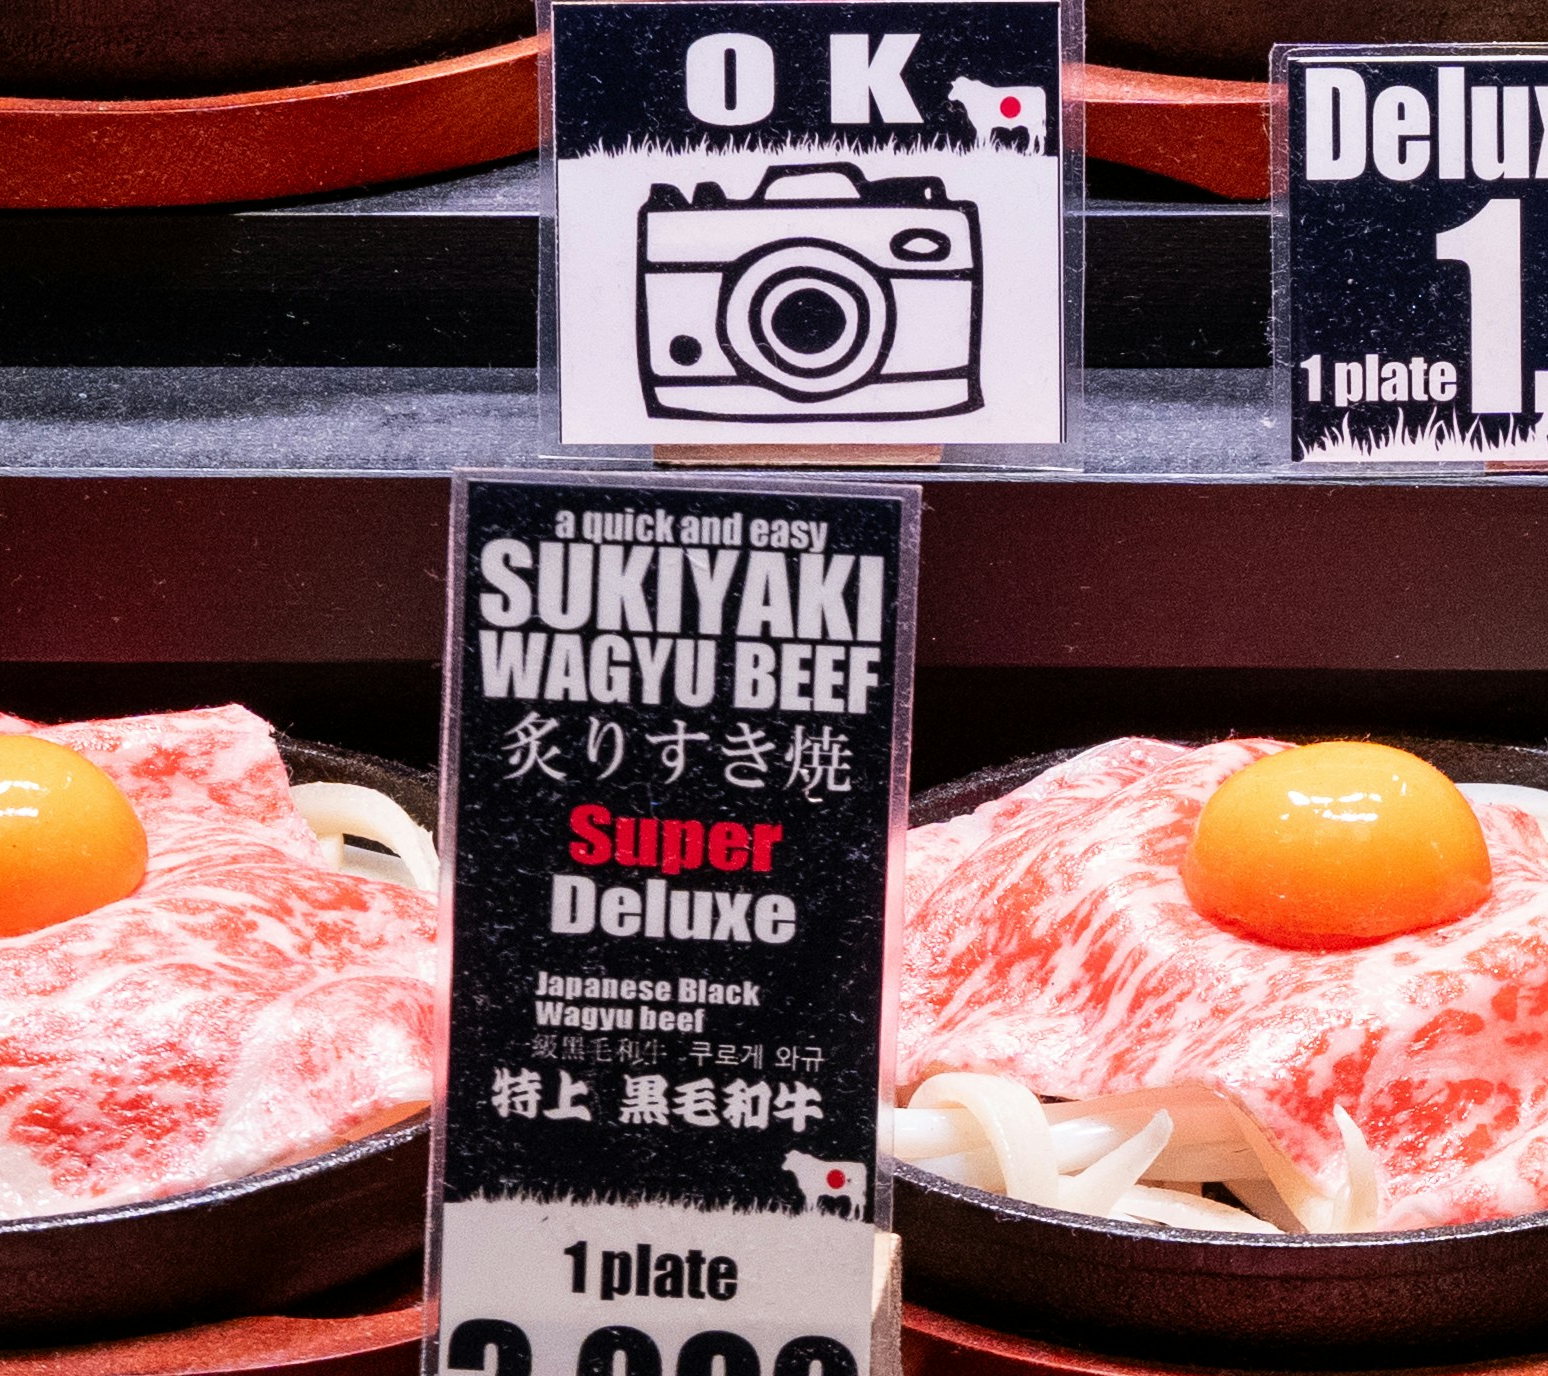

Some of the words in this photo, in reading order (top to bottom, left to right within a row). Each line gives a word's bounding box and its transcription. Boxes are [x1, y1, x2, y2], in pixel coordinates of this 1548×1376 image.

[1299, 354, 1322, 402] 1
[1334, 353, 1456, 408] plate
[555, 510, 575, 539] a
[582, 509, 675, 544] quick
[680, 512, 743, 546] and
[749, 518, 828, 553] easy
[479, 538, 884, 642] SUKIYAKI
[479, 630, 717, 708] WAGYU
[733, 640, 882, 714] BEEF
[502, 711, 853, 795] 炙りすき焼
[569, 804, 783, 875] Super
[550, 874, 796, 944] Deluxe
[535, 971, 672, 1002] Japanese
[678, 977, 760, 1007] Black
[535, 1000, 634, 1031] Wagyu
[639, 1005, 705, 1033] beef
[689, 1041, 763, 1069] 쿠로게
[775, 1046, 825, 1072] 와규
[491, 1067, 592, 1122] 特上
[618, 1074, 824, 1132] 黒毛和牛
[563, 1240, 588, 1294] 1
[600, 1243, 738, 1301] plate
